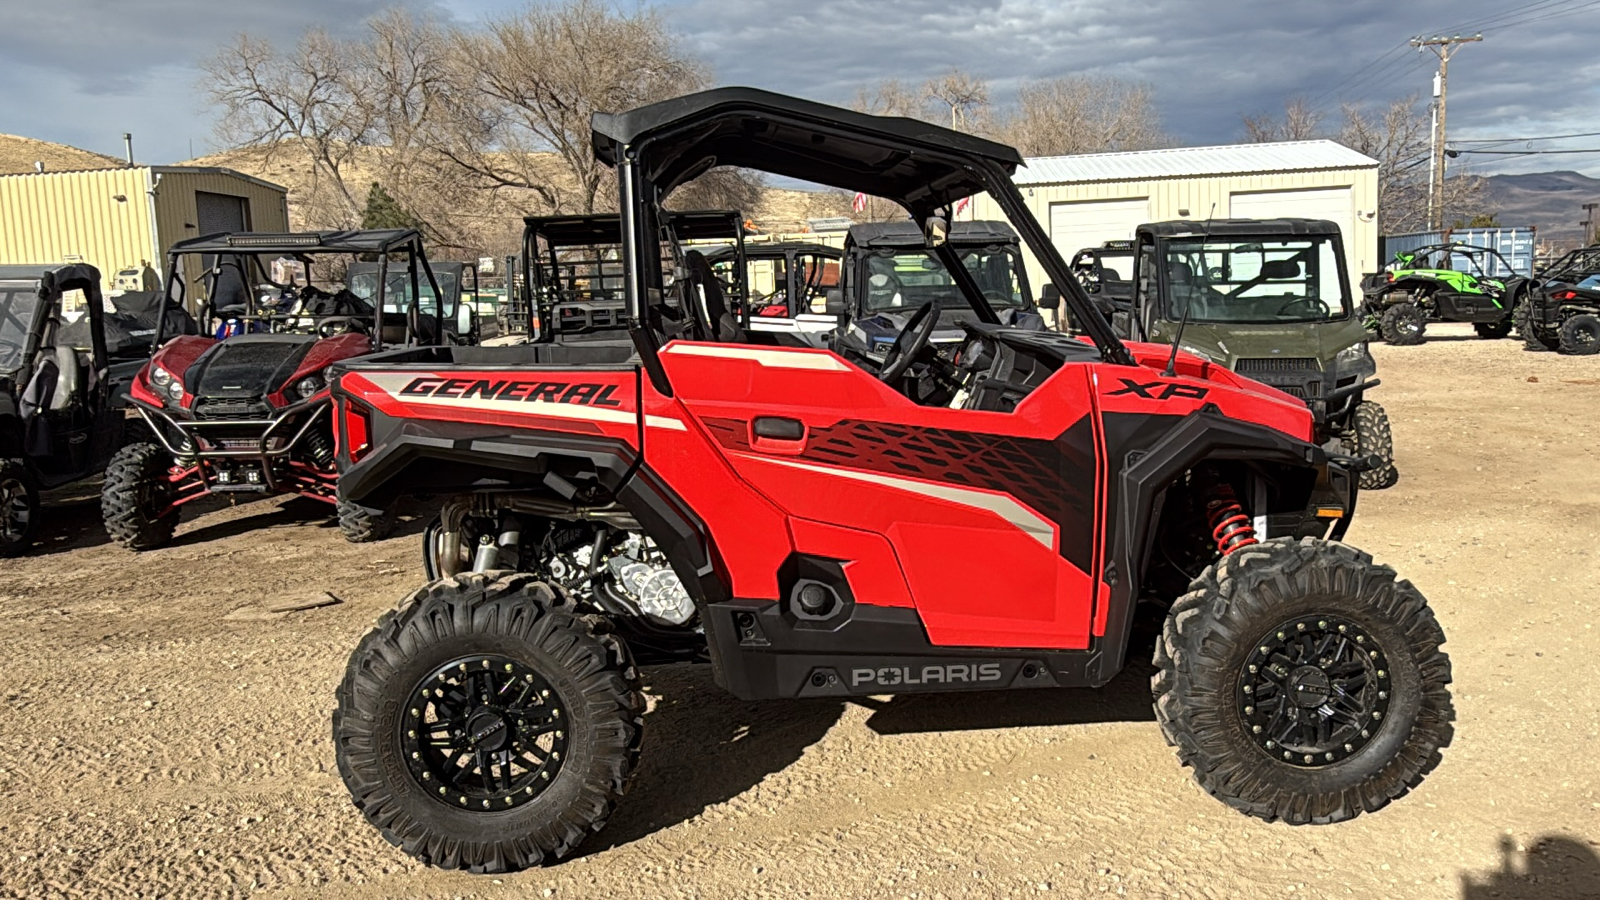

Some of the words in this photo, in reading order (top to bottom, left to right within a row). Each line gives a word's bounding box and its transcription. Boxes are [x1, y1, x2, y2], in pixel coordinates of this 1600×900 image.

[399, 377, 621, 405] GENERAL
[1102, 378, 1210, 399] XP
[852, 663, 1002, 686] POLARIS
